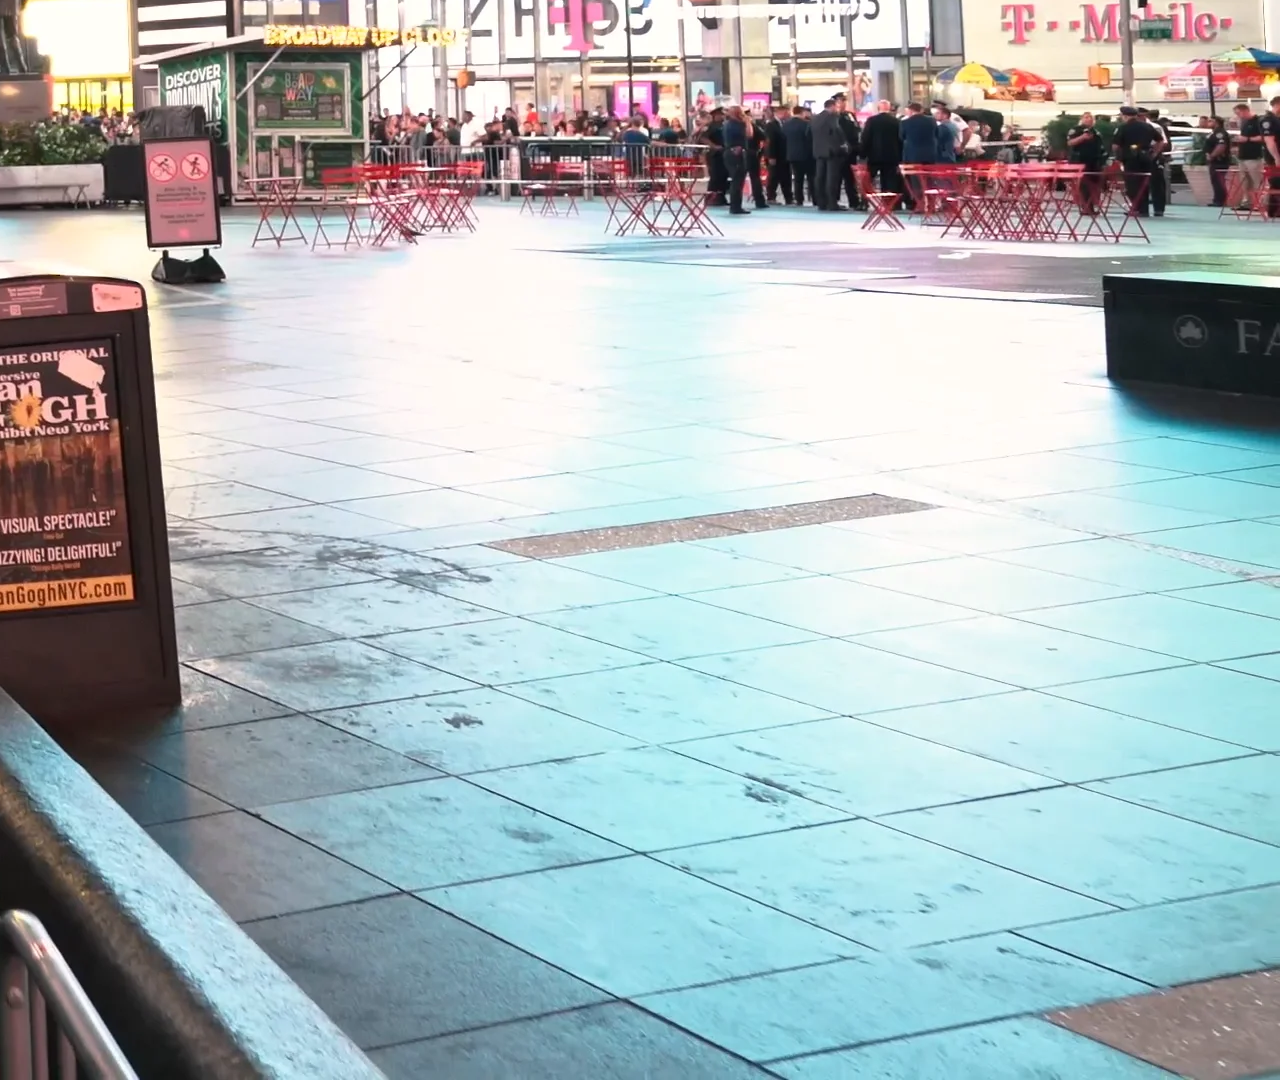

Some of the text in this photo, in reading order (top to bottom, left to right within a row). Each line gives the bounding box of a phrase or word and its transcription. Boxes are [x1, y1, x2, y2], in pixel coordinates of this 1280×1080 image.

[264, 24, 370, 46] BROADWAY
[371, 29, 398, 46] UP
[165, 64, 221, 90] DISCOVER
[30, 347, 109, 363] ORINAL
[34, 424, 69, 436] New
[72, 421, 110, 433] York
[1, 517, 42, 534] VISUAL
